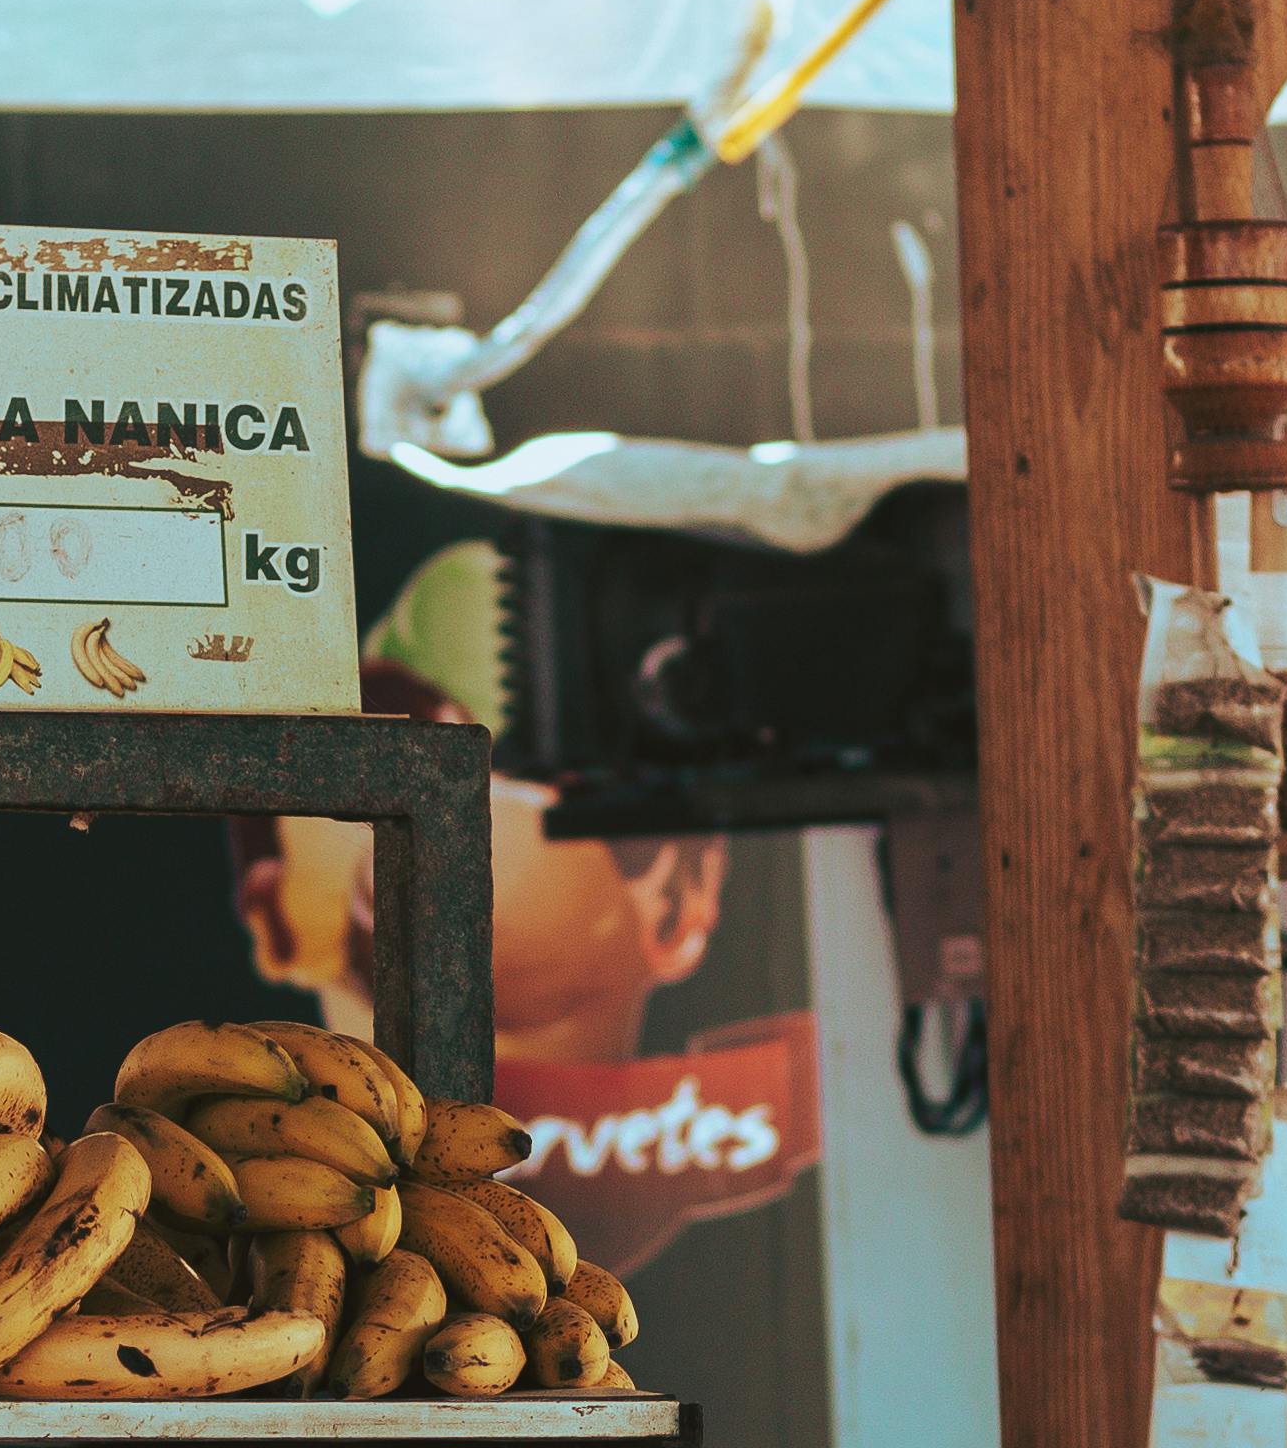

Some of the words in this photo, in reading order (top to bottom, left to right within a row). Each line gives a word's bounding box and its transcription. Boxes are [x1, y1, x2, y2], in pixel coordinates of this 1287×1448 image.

[63, 398, 311, 453] NANICA
[244, 532, 322, 593] kg
[503, 1078, 779, 1178] rvetes
